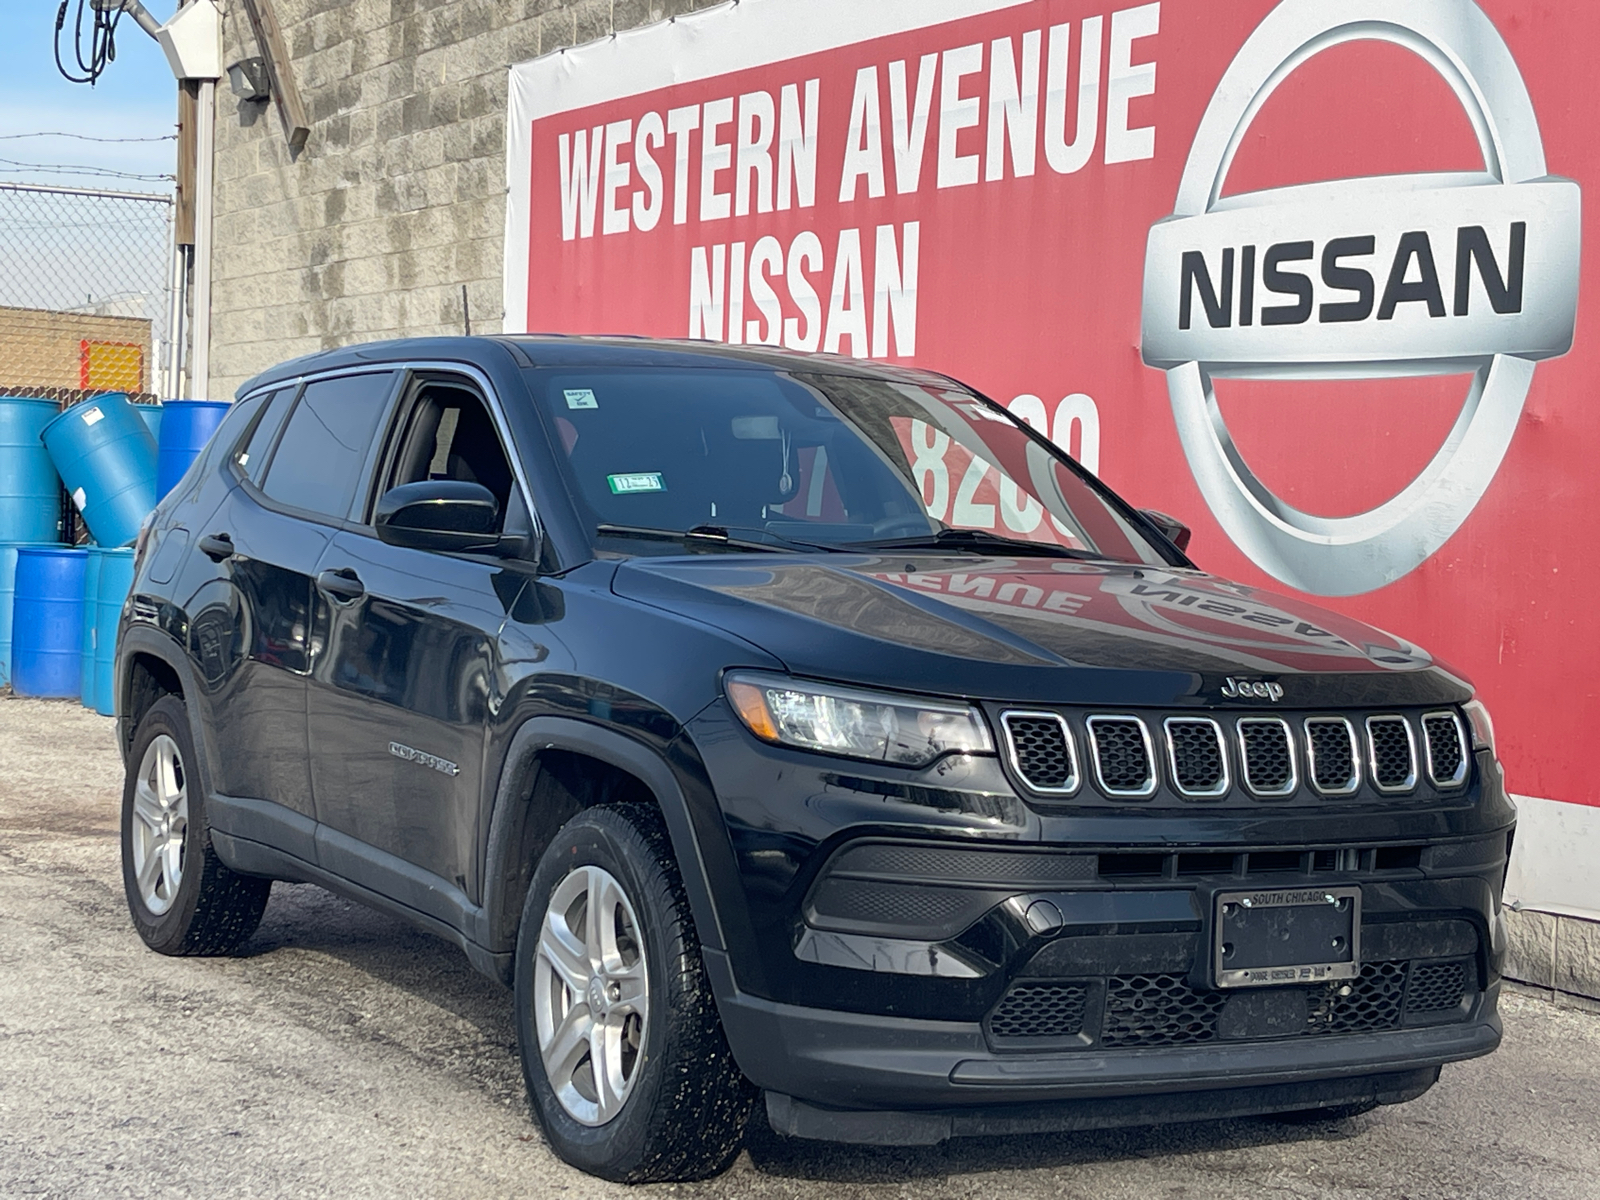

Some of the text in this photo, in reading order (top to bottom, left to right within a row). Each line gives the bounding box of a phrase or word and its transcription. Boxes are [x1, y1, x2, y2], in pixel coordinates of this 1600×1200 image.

[558, 1, 1161, 242] WESTERN AVENUE
[689, 220, 920, 359] NISSAN
[1179, 221, 1527, 330] NISSAN
[1221, 677, 1284, 702] Jeep
[1252, 891, 1326, 905] SOUTH CHICAGO
